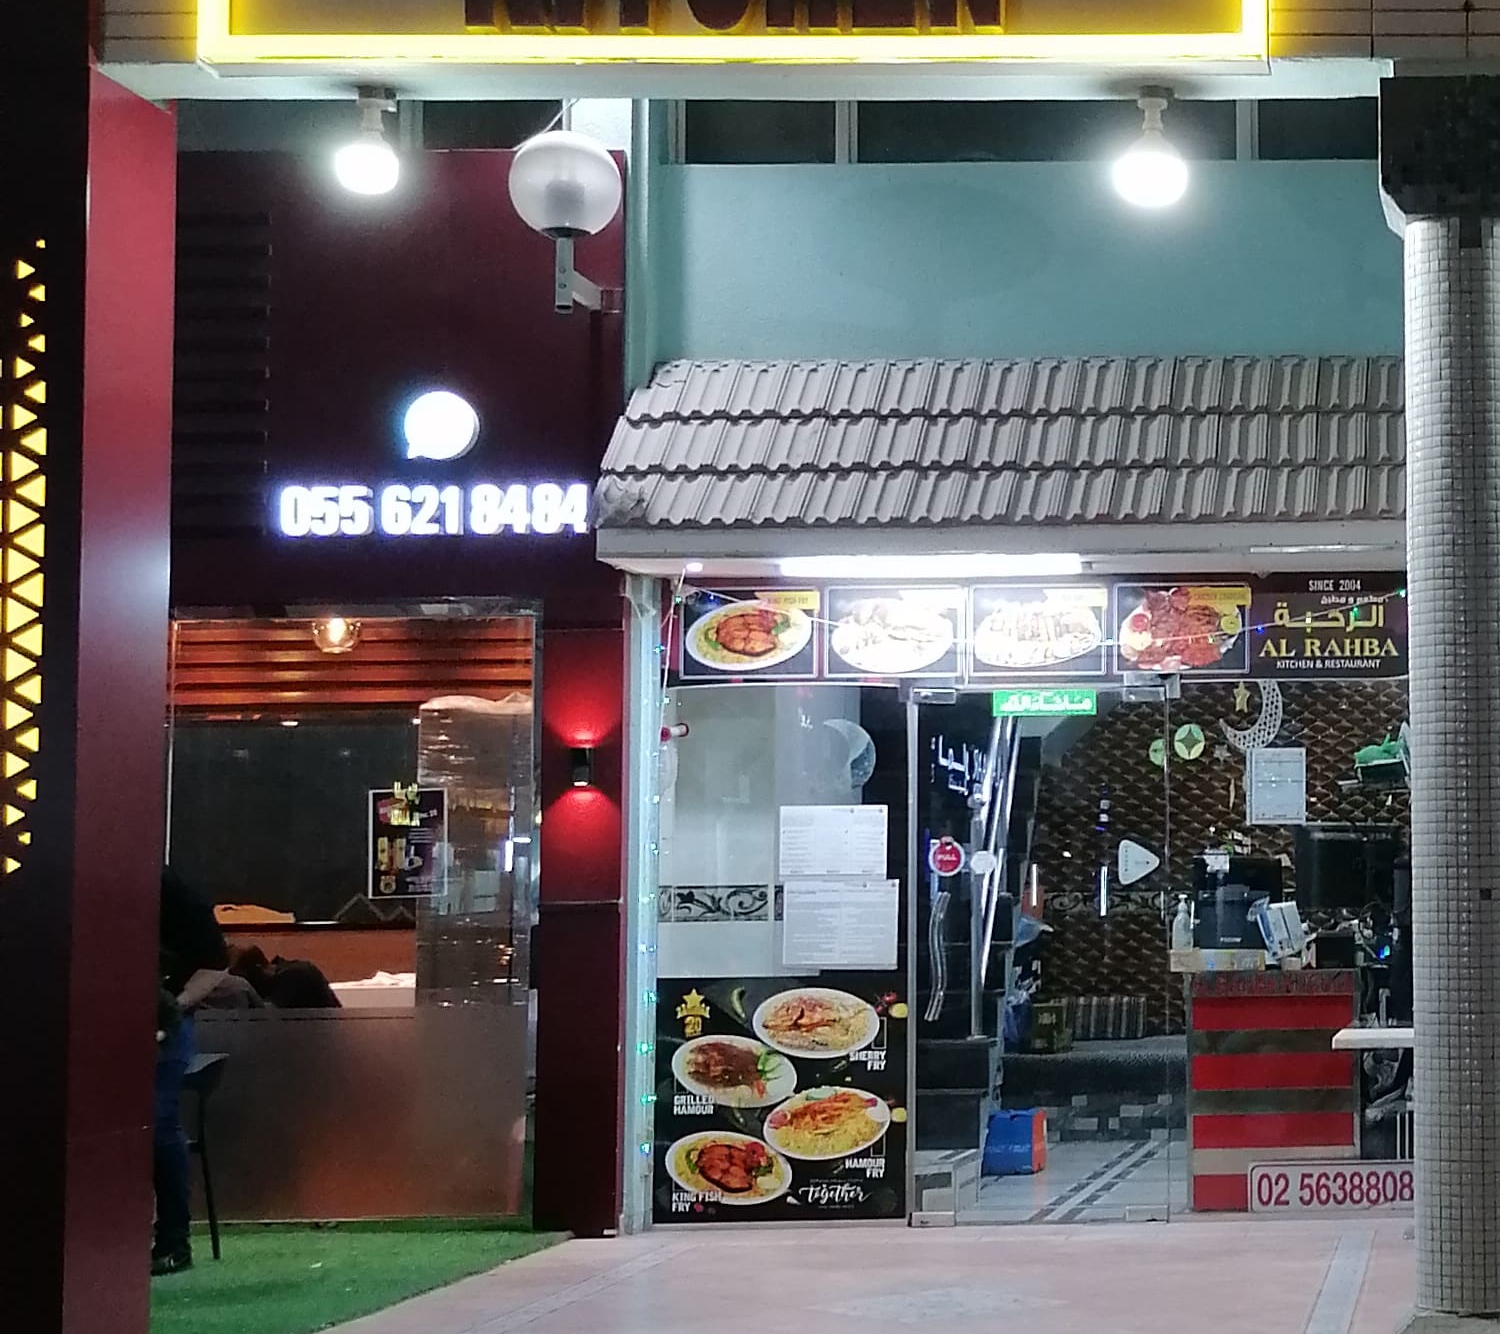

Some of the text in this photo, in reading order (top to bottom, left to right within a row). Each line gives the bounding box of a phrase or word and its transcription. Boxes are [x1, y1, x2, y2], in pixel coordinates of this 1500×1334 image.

[280, 483, 588, 536] 055 621 8484
[1308, 579, 1361, 591] SINCE 2004
[1274, 602, 1385, 633] الرحبة
[1259, 637, 1400, 657] AL RAHBA
[1276, 659, 1381, 669] KITCHEN & RESTAURANT
[867, 1060, 886, 1071] FRY
[673, 1095, 715, 1106] GRILLED
[673, 1105, 714, 1115] HAMOUR
[845, 1158, 885, 1169] HAMOUR
[866, 1168, 884, 1178] FRY
[799, 1183, 873, 1204] together
[1257, 1170, 1414, 1207] 02 5638808
[672, 1191, 722, 1203] KING FISH
[672, 1202, 691, 1213] FRY
